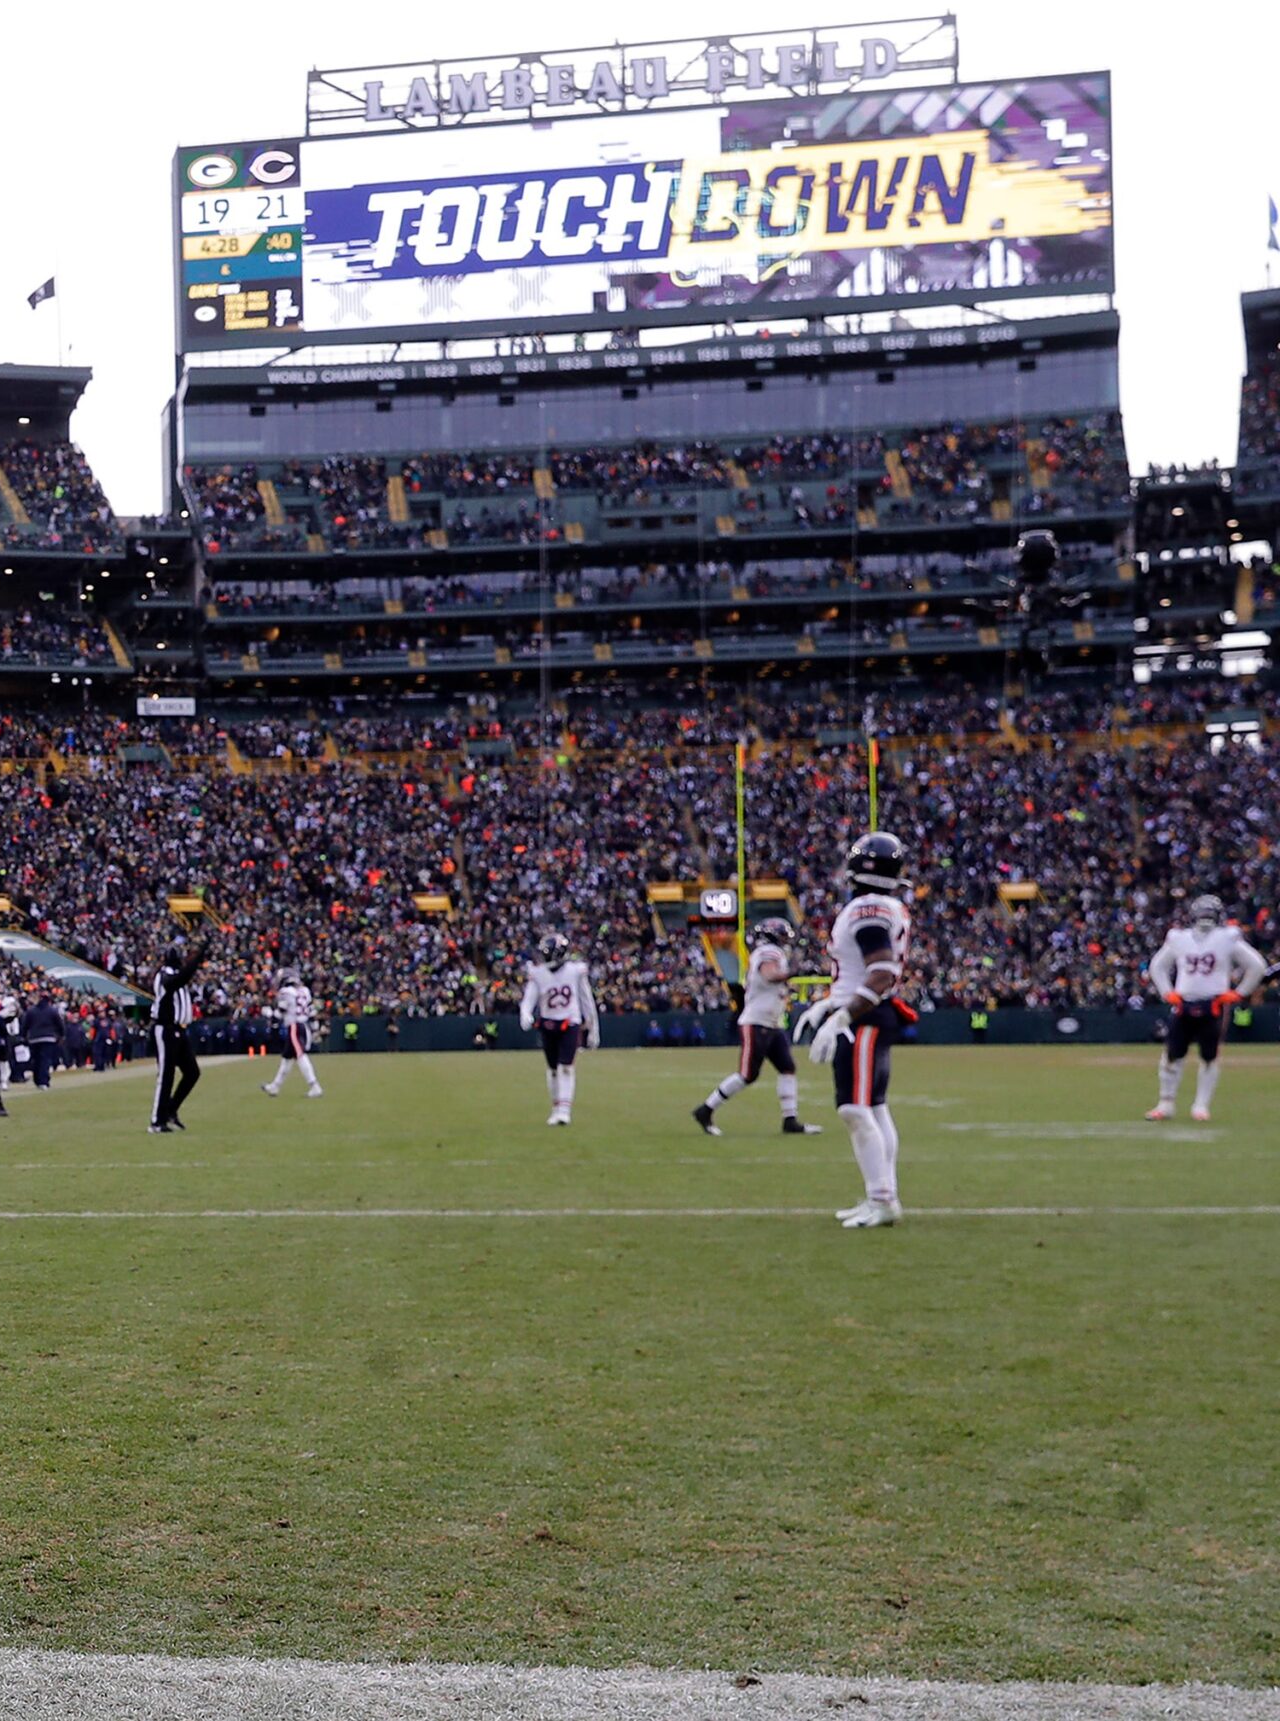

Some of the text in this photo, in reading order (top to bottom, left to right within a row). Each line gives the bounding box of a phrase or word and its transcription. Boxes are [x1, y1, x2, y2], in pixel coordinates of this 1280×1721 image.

[363, 38, 899, 121] LAMBEAU FIELD
[198, 199, 230, 224] 19
[256, 194, 289, 220] 21
[367, 152, 976, 266] TOUCHDOWN
[200, 238, 239, 253] 4:28
[268, 326, 1017, 385] WORLD CHAMPIONS 1929 1930 1931 1936 1939 1944 1961 1962 1965 1966 1967 1996 2010
[705, 893, 733, 914] 40
[548, 985, 571, 1009] 29
